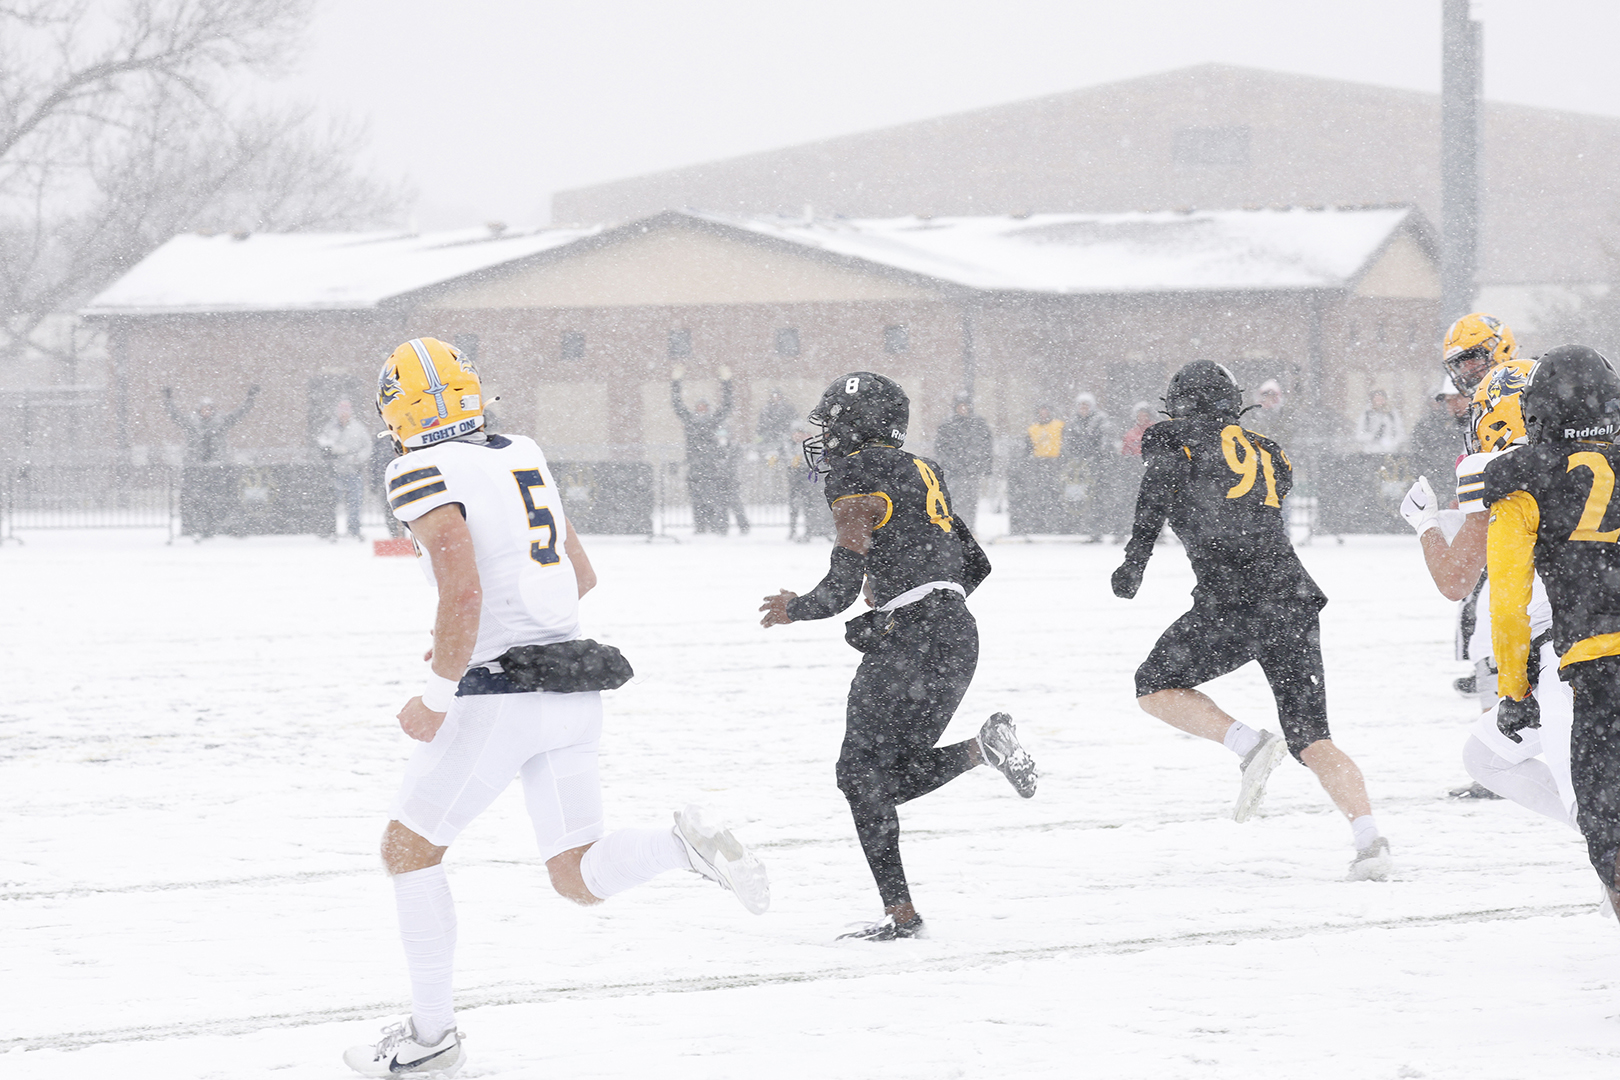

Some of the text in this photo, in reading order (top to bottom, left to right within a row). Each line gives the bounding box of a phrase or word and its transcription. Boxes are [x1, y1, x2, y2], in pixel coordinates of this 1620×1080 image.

[845, 377, 860, 394] 8
[421, 425, 456, 445] FIGHT
[1564, 424, 1614, 439] Riddell
[1220, 424, 1281, 509] 91
[510, 467, 560, 567] 5
[913, 458, 954, 533] 8
